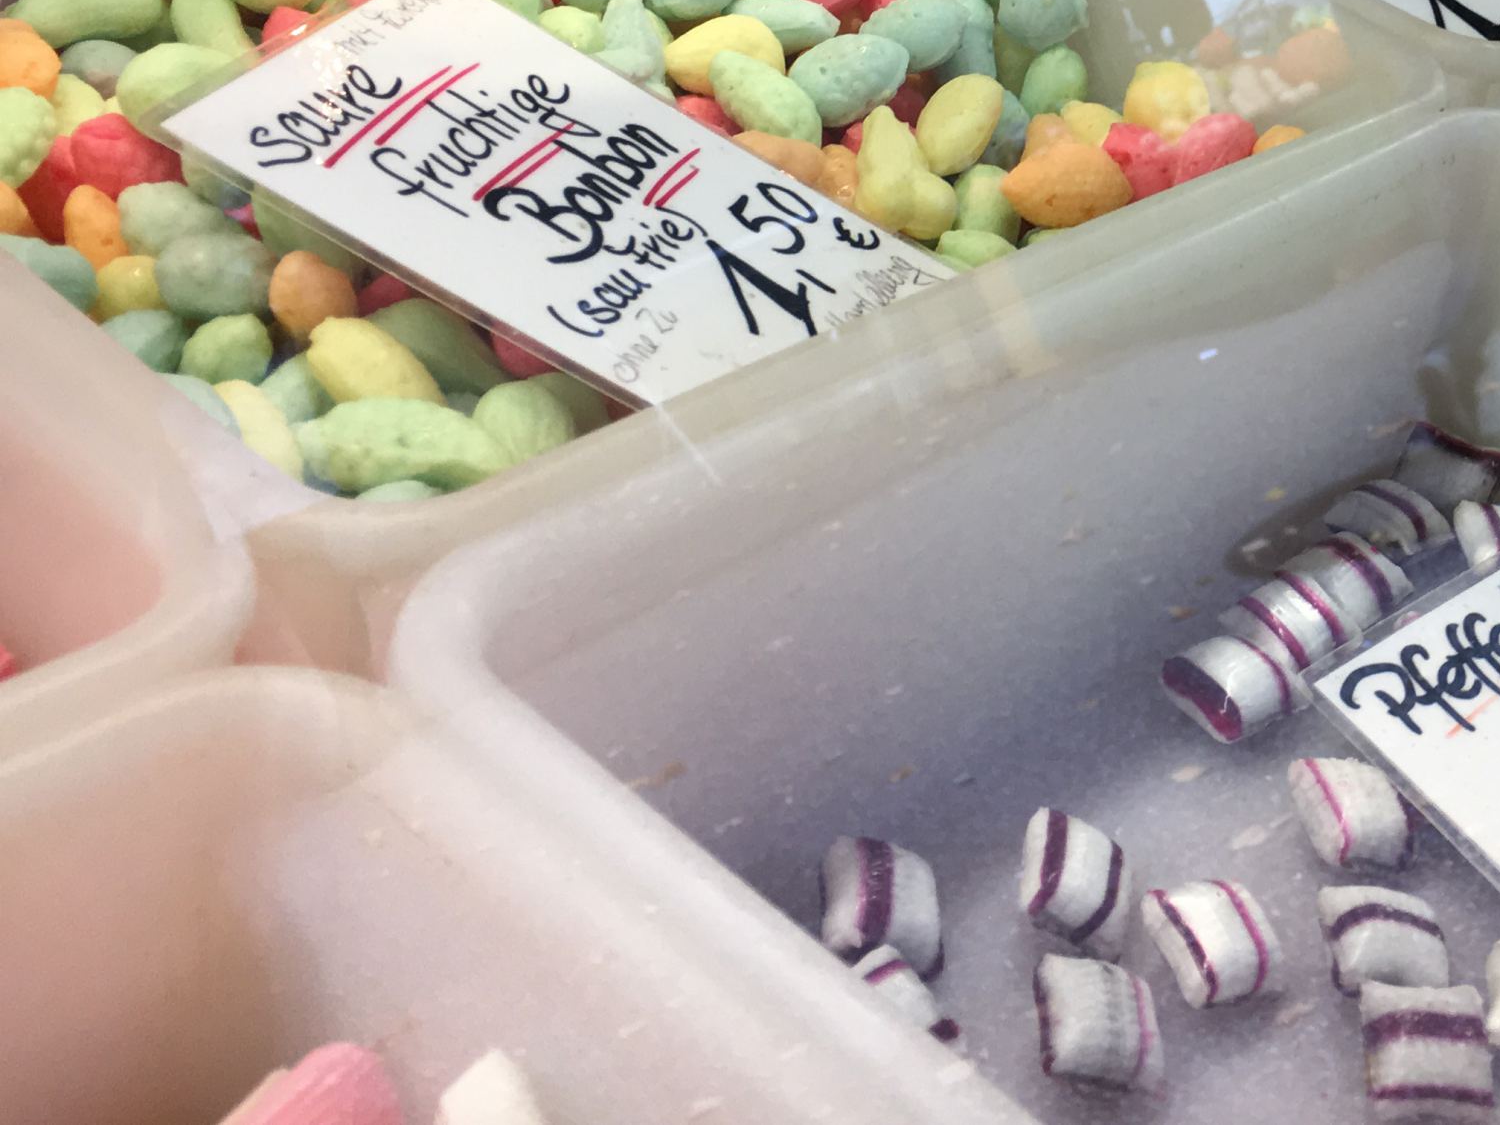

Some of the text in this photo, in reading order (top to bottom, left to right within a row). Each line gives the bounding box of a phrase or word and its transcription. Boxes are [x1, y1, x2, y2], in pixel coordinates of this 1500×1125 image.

[369, 74, 602, 218] fruchtige
[483, 123, 679, 264] Bonbon
[833, 217, 880, 251] €
